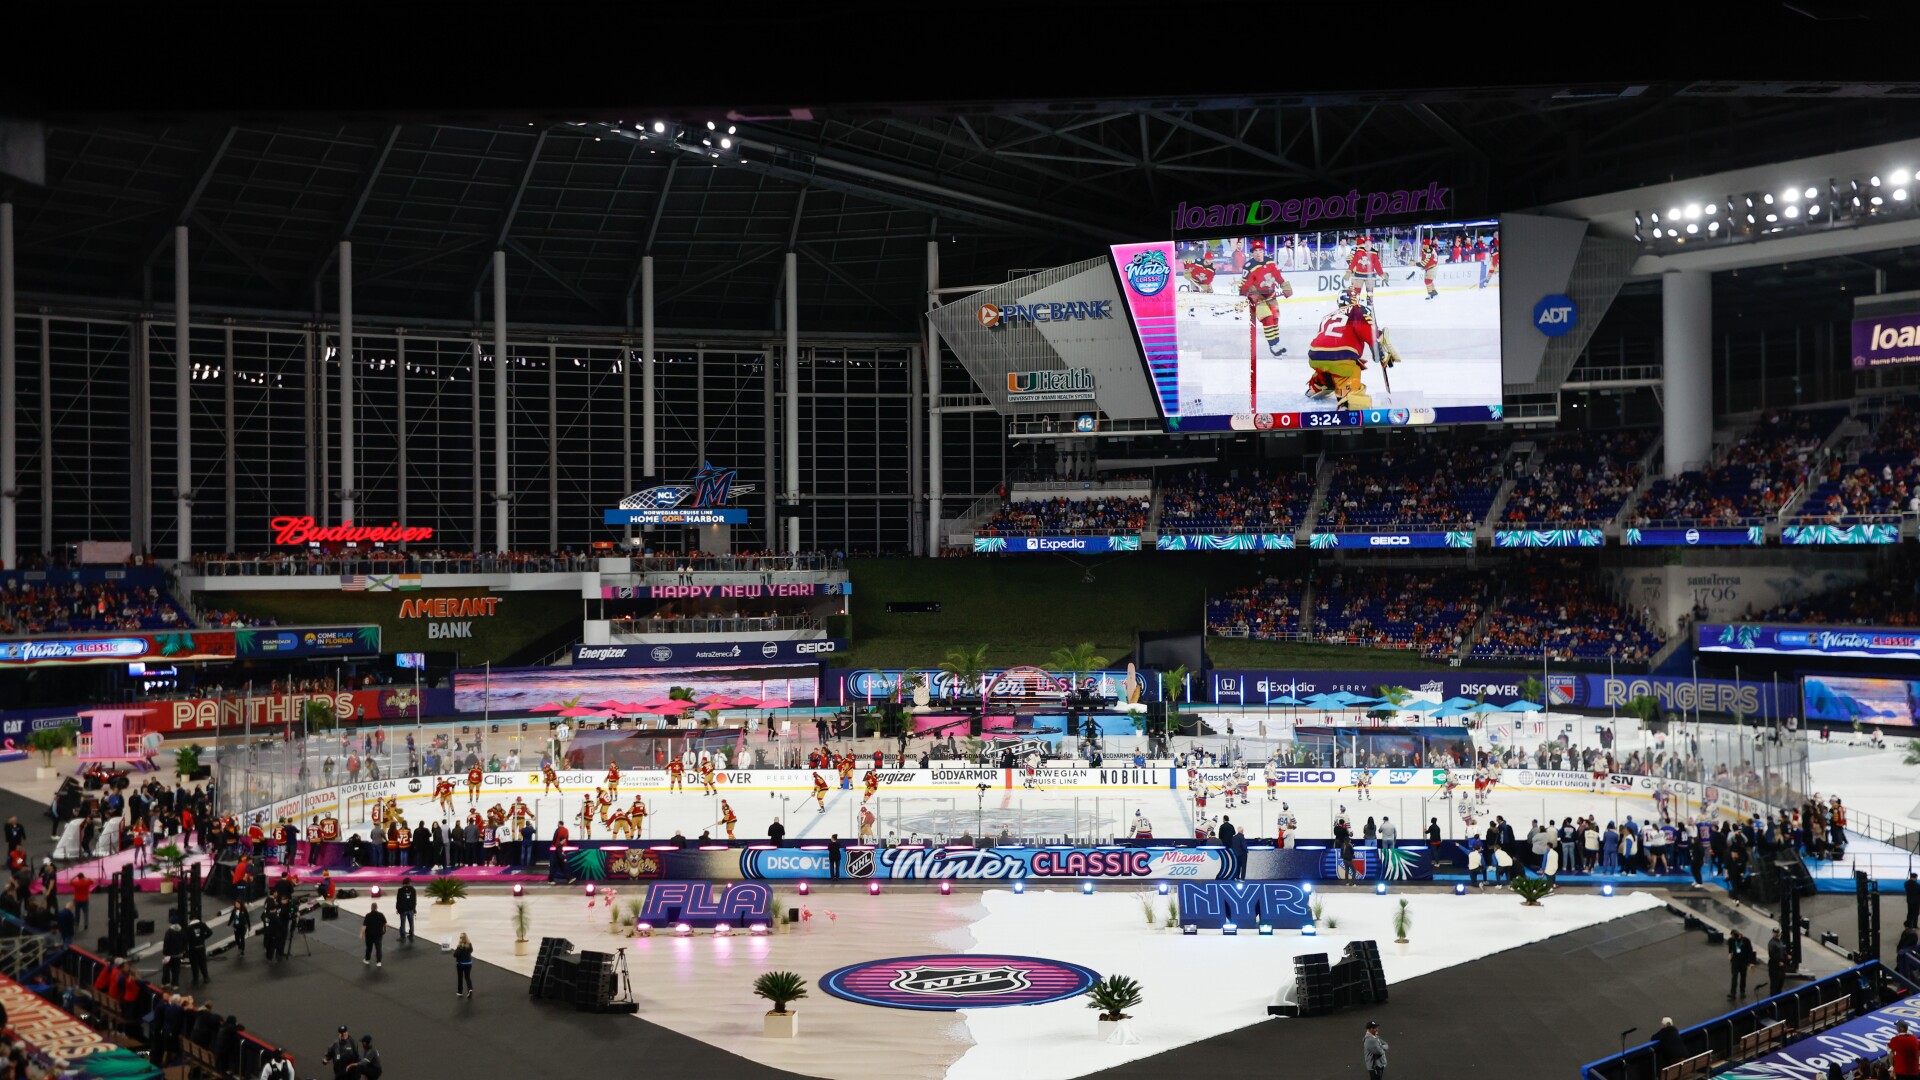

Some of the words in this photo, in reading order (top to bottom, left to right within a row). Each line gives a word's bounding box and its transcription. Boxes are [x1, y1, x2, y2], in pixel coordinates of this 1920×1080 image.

[1364, 181, 1450, 223] park
[1124, 262, 1171, 280] Winter
[1136, 275, 1161, 283] CLASSIC
[1318, 273, 1389, 292] DISCER
[1538, 307, 1572, 324] ADT
[1871, 323, 1920, 351] loa
[1078, 418, 1092, 428] 42
[1281, 415, 1291, 426] 0
[1309, 414, 1341, 426] 3:24
[1371, 412, 1381, 422] 0
[657, 491, 675, 499] NCL
[686, 515, 725, 523] HARBOR
[271, 515, 433, 544] Budweiser
[1040, 538, 1086, 551] Expedia
[1370, 536, 1409, 545] GEICO
[651, 585, 714, 599] HAPPY
[721, 585, 762, 598] NEW
[767, 583, 815, 597] YEAR!
[1692, 585, 1737, 607] 1796
[399, 598, 499, 619] AMERANT
[428, 621, 473, 640] BANK
[1820, 631, 1870, 650] Winter
[1872, 635, 1915, 647] CLASSIC
[20, 642, 75, 662] Winter
[75, 643, 119, 653] CLASSIC
[578, 647, 627, 661] Energizer
[796, 641, 835, 654] GEICO
[1449, 658, 1462, 667] 387
[1332, 684, 1367, 692] PERRY
[1460, 683, 1518, 696] DISCOVER
[1603, 678, 1760, 715] RANGERS
[4, 720, 24, 734] CAT
[484, 774, 513, 787] Clips
[544, 773, 593, 785] pedia
[687, 772, 752, 785] DISOVER
[863, 770, 916, 785] Eergizer
[931, 770, 998, 781] BODYARMOR
[1019, 769, 1087, 778] NRWEGIAN
[1100, 769, 1158, 784] NOBULL
[1276, 771, 1335, 783] GEICO
[1390, 771, 1412, 783] SAP
[1556, 772, 1589, 780] FEDERAL
[341, 780, 396, 795] NORWEGIAN
[1535, 779, 1561, 787] CREDIT
[1562, 780, 1590, 788] UNION
[372, 789, 388, 798] LINE
[275, 800, 300, 819] verizon
[304, 791, 337, 807] HONDA
[324, 823, 334, 834] 40
[767, 856, 831, 870] DISCOVE
[851, 854, 872, 872] NHL
[882, 848, 1026, 879] Winter
[1030, 851, 1153, 876] CLASSIC
[1161, 850, 1206, 864] Miami
[1168, 865, 1198, 876] 2026
[645, 881, 772, 918] FLA
[1180, 882, 1310, 917] NYR
[922, 972, 1003, 991] NHL
